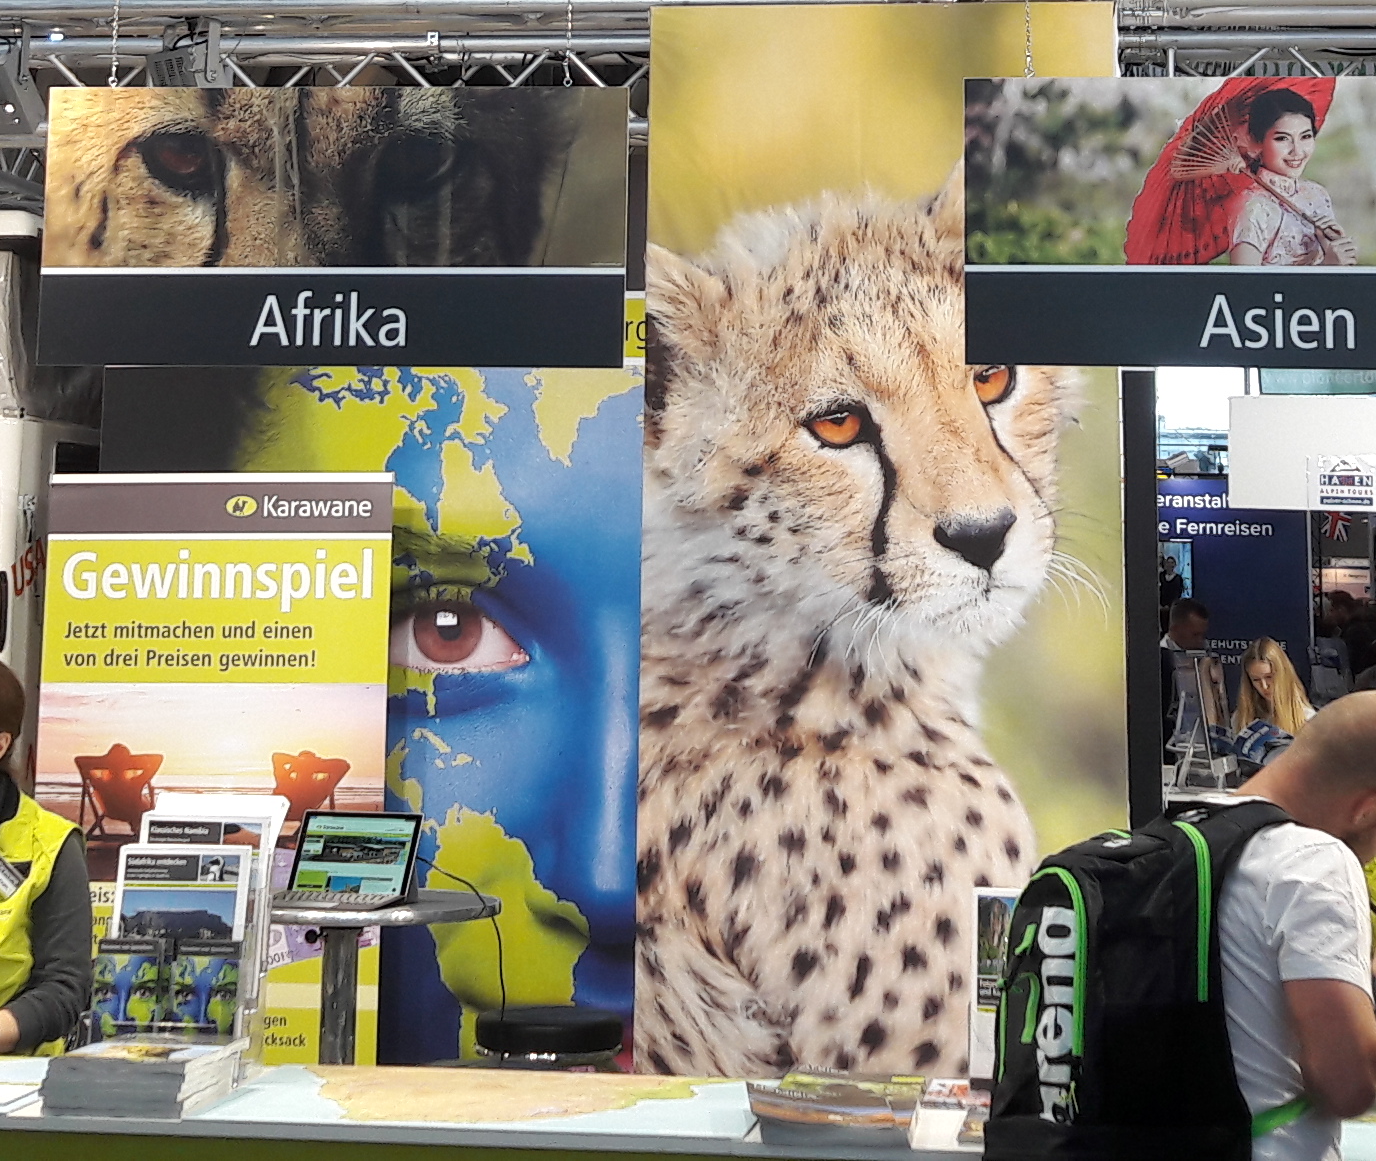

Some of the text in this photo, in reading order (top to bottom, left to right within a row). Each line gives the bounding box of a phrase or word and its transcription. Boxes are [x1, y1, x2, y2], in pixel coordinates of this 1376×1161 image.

[249, 290, 409, 348] Afrika
[1199, 292, 1357, 350] Asien
[1320, 474, 1373, 486] HAEN
[262, 495, 373, 518] Karawane
[1176, 519, 1273, 537] Fernreisen
[62, 548, 373, 613] Gewinnspiel
[64, 621, 313, 640] Jetzt mitmachen und einen
[63, 649, 317, 672] von drei Preisen gewinnen!
